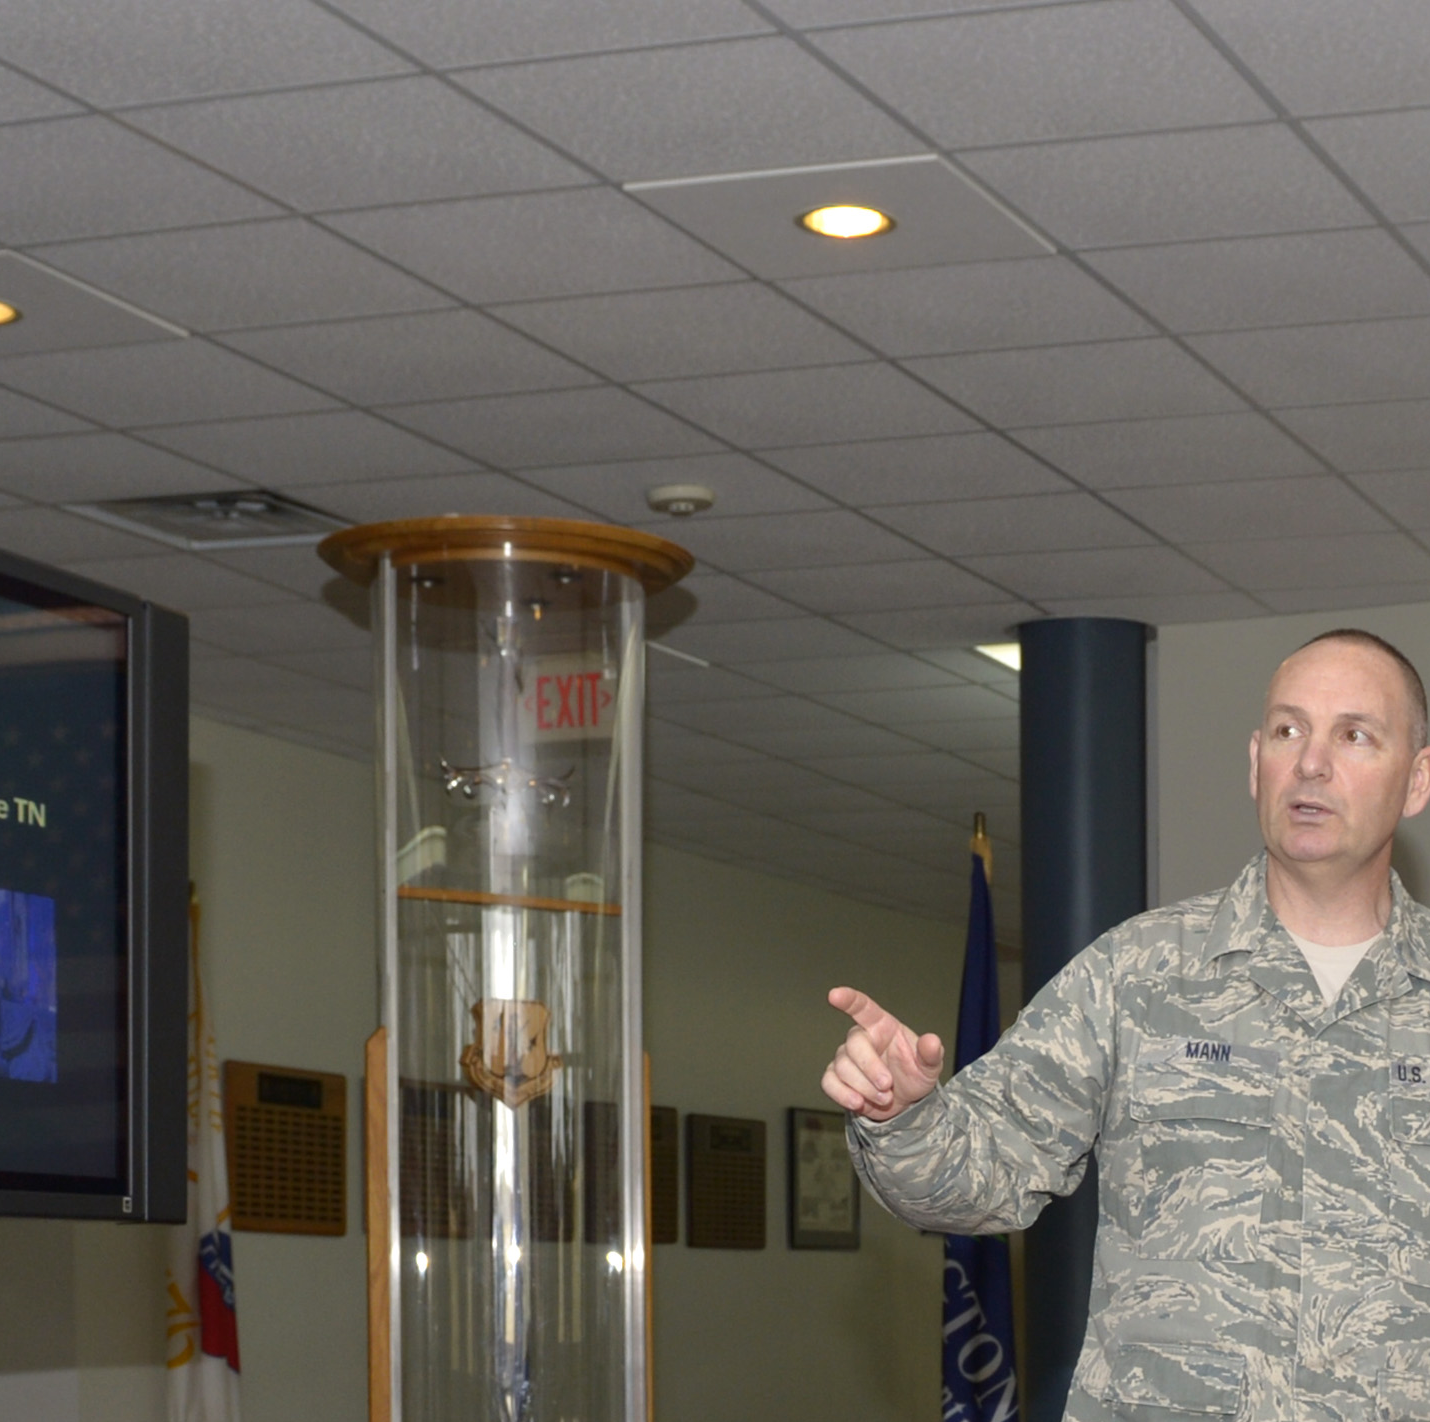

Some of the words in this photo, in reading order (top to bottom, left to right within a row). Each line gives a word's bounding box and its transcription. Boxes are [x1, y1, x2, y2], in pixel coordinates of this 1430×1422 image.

[536, 674, 603, 731] EXIT
[14, 797, 48, 829] TN
[1185, 1041, 1232, 1062] MANN
[1397, 1064, 1427, 1085] U.S.
